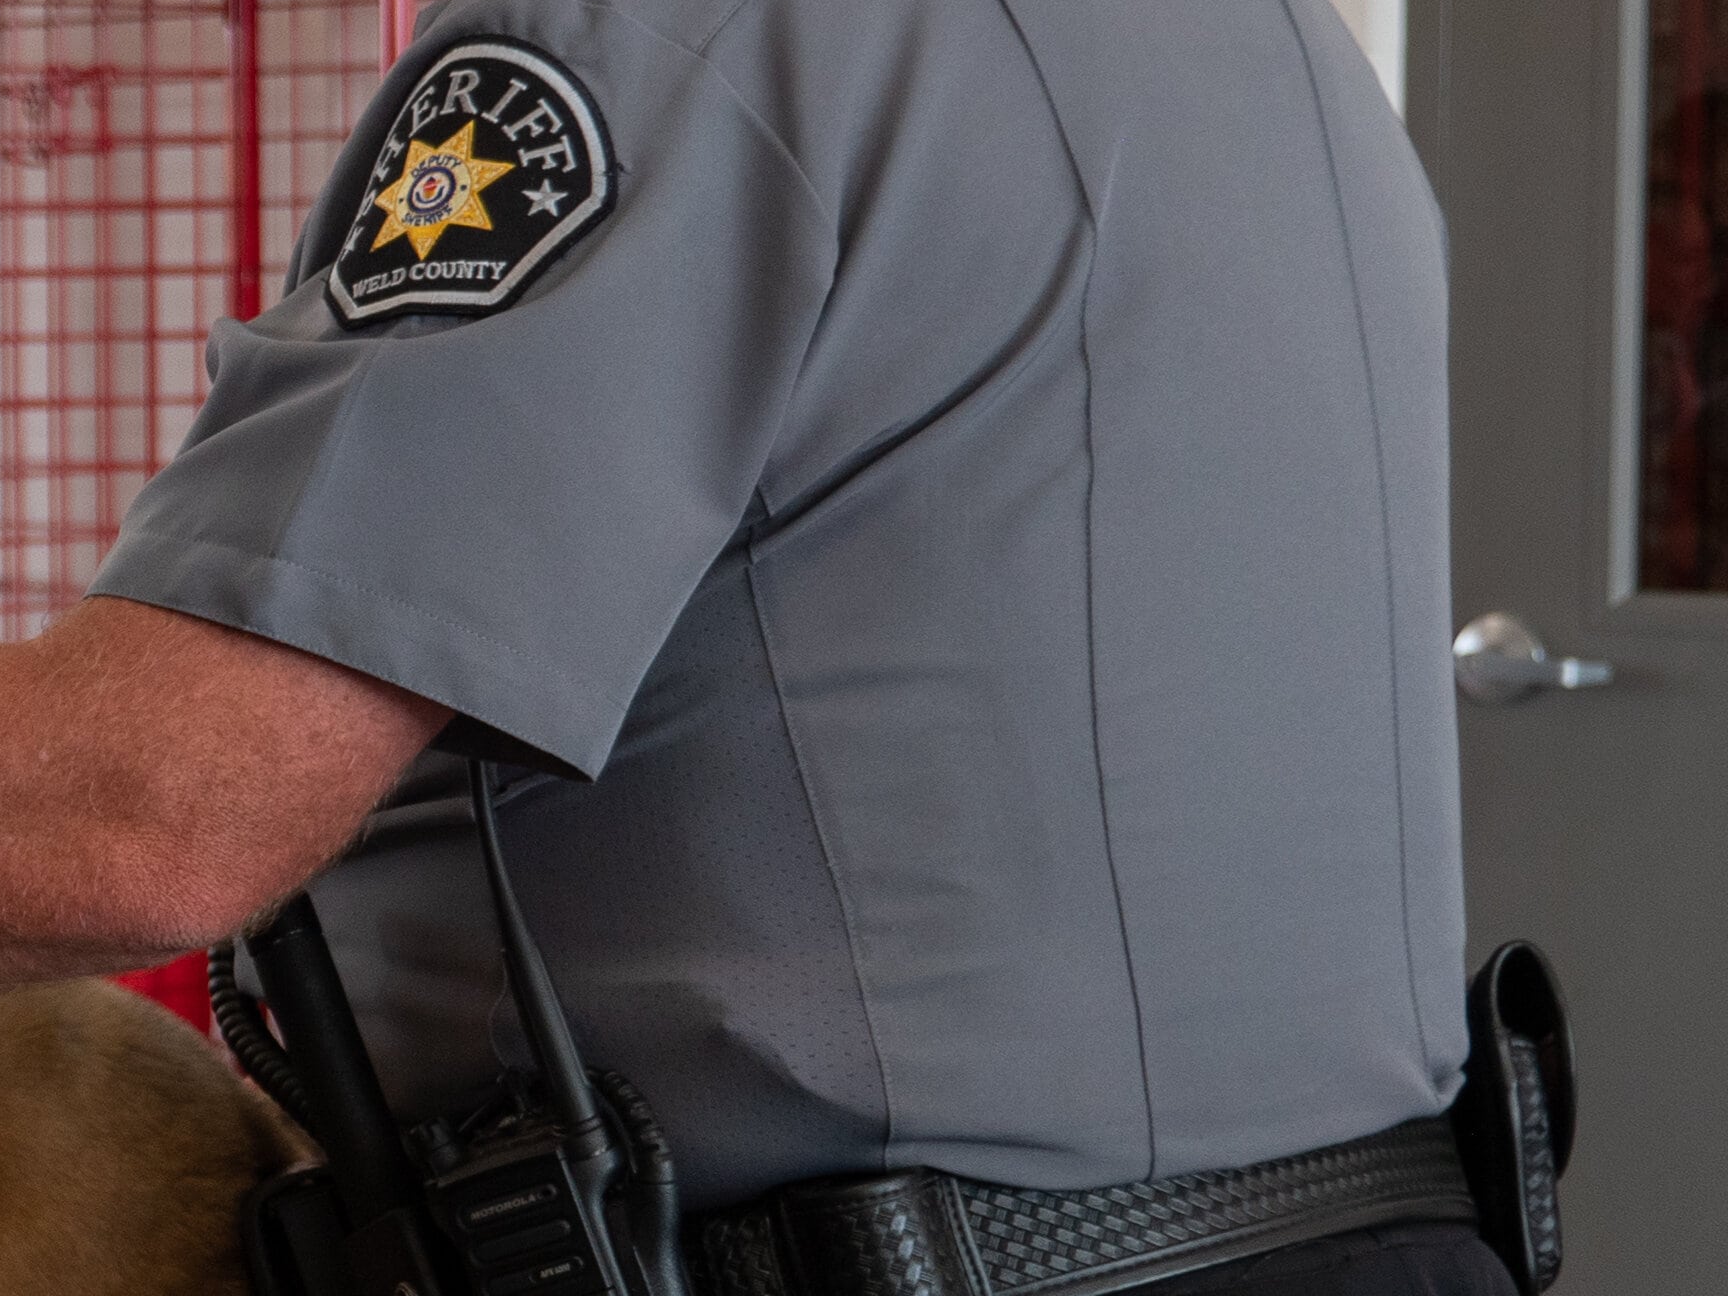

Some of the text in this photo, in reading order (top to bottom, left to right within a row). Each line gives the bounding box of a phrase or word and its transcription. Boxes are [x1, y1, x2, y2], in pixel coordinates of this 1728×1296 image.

[359, 68, 577, 218] SHERIFF
[411, 154, 462, 179] DEPUTY
[352, 260, 507, 298] WELD COUNTY
[470, 1193, 537, 1221] MOTOROLA
